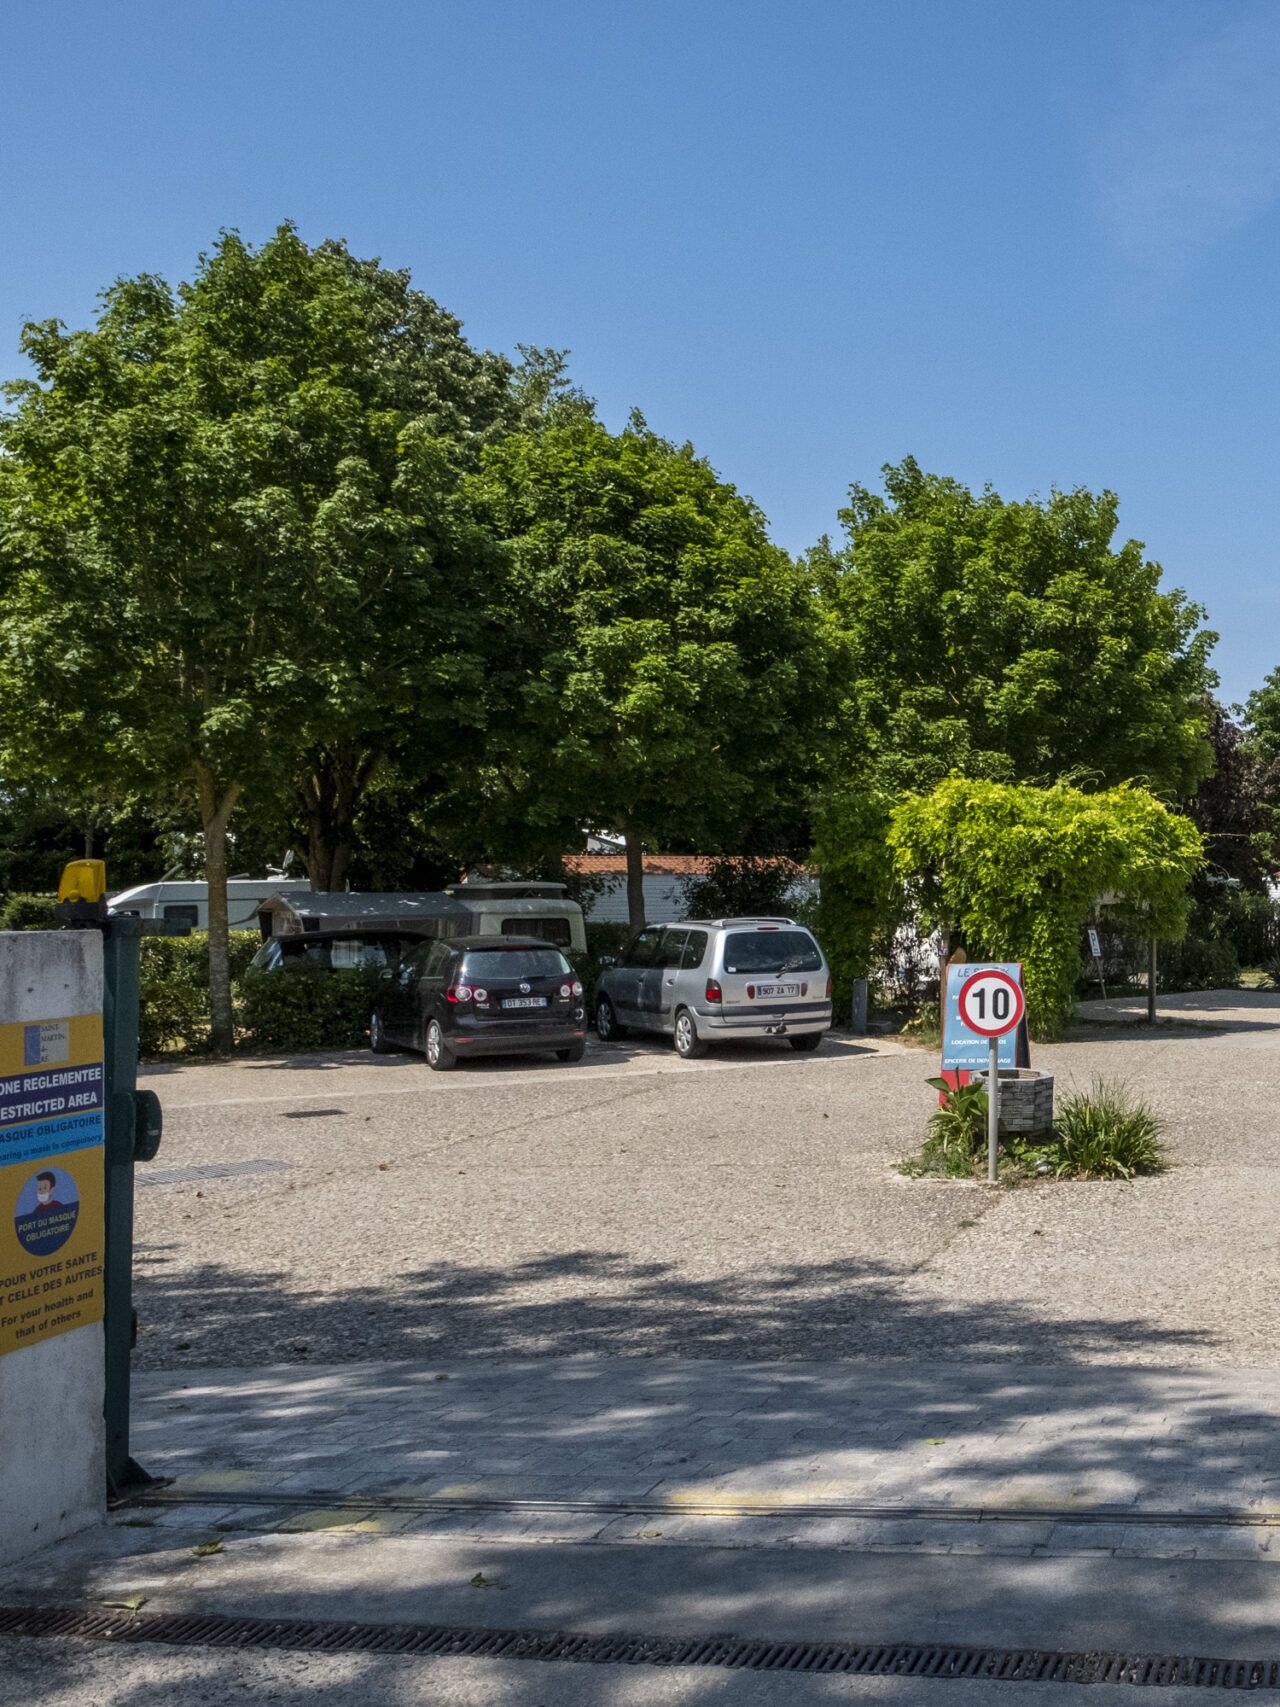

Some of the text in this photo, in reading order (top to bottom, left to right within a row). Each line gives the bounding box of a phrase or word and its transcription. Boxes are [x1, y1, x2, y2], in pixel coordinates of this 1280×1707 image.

[957, 968, 970, 977] LE
[972, 988, 1009, 1020] 10
[0, 1067, 101, 1096] ONE REGLEMENTEE
[0, 1091, 98, 1120] ESTRICTED AREA
[0, 1114, 101, 1144] ASQUE OBLIGATOIRE
[31, 1144, 50, 1154] mask
[61, 1134, 102, 1147] compulsory
[18, 1210, 76, 1232] PORT DU MASQUE
[25, 1223, 70, 1242] OBLIGATOIRE
[29, 1262, 63, 1280] VOTRE
[65, 1251, 97, 1269] SANTE
[7, 1285, 41, 1303] CELLE
[43, 1278, 62, 1293] DES
[65, 1265, 103, 1286] AUTRES
[1, 1288, 94, 1327] For your health and
[16, 1310, 81, 1339] that of others
